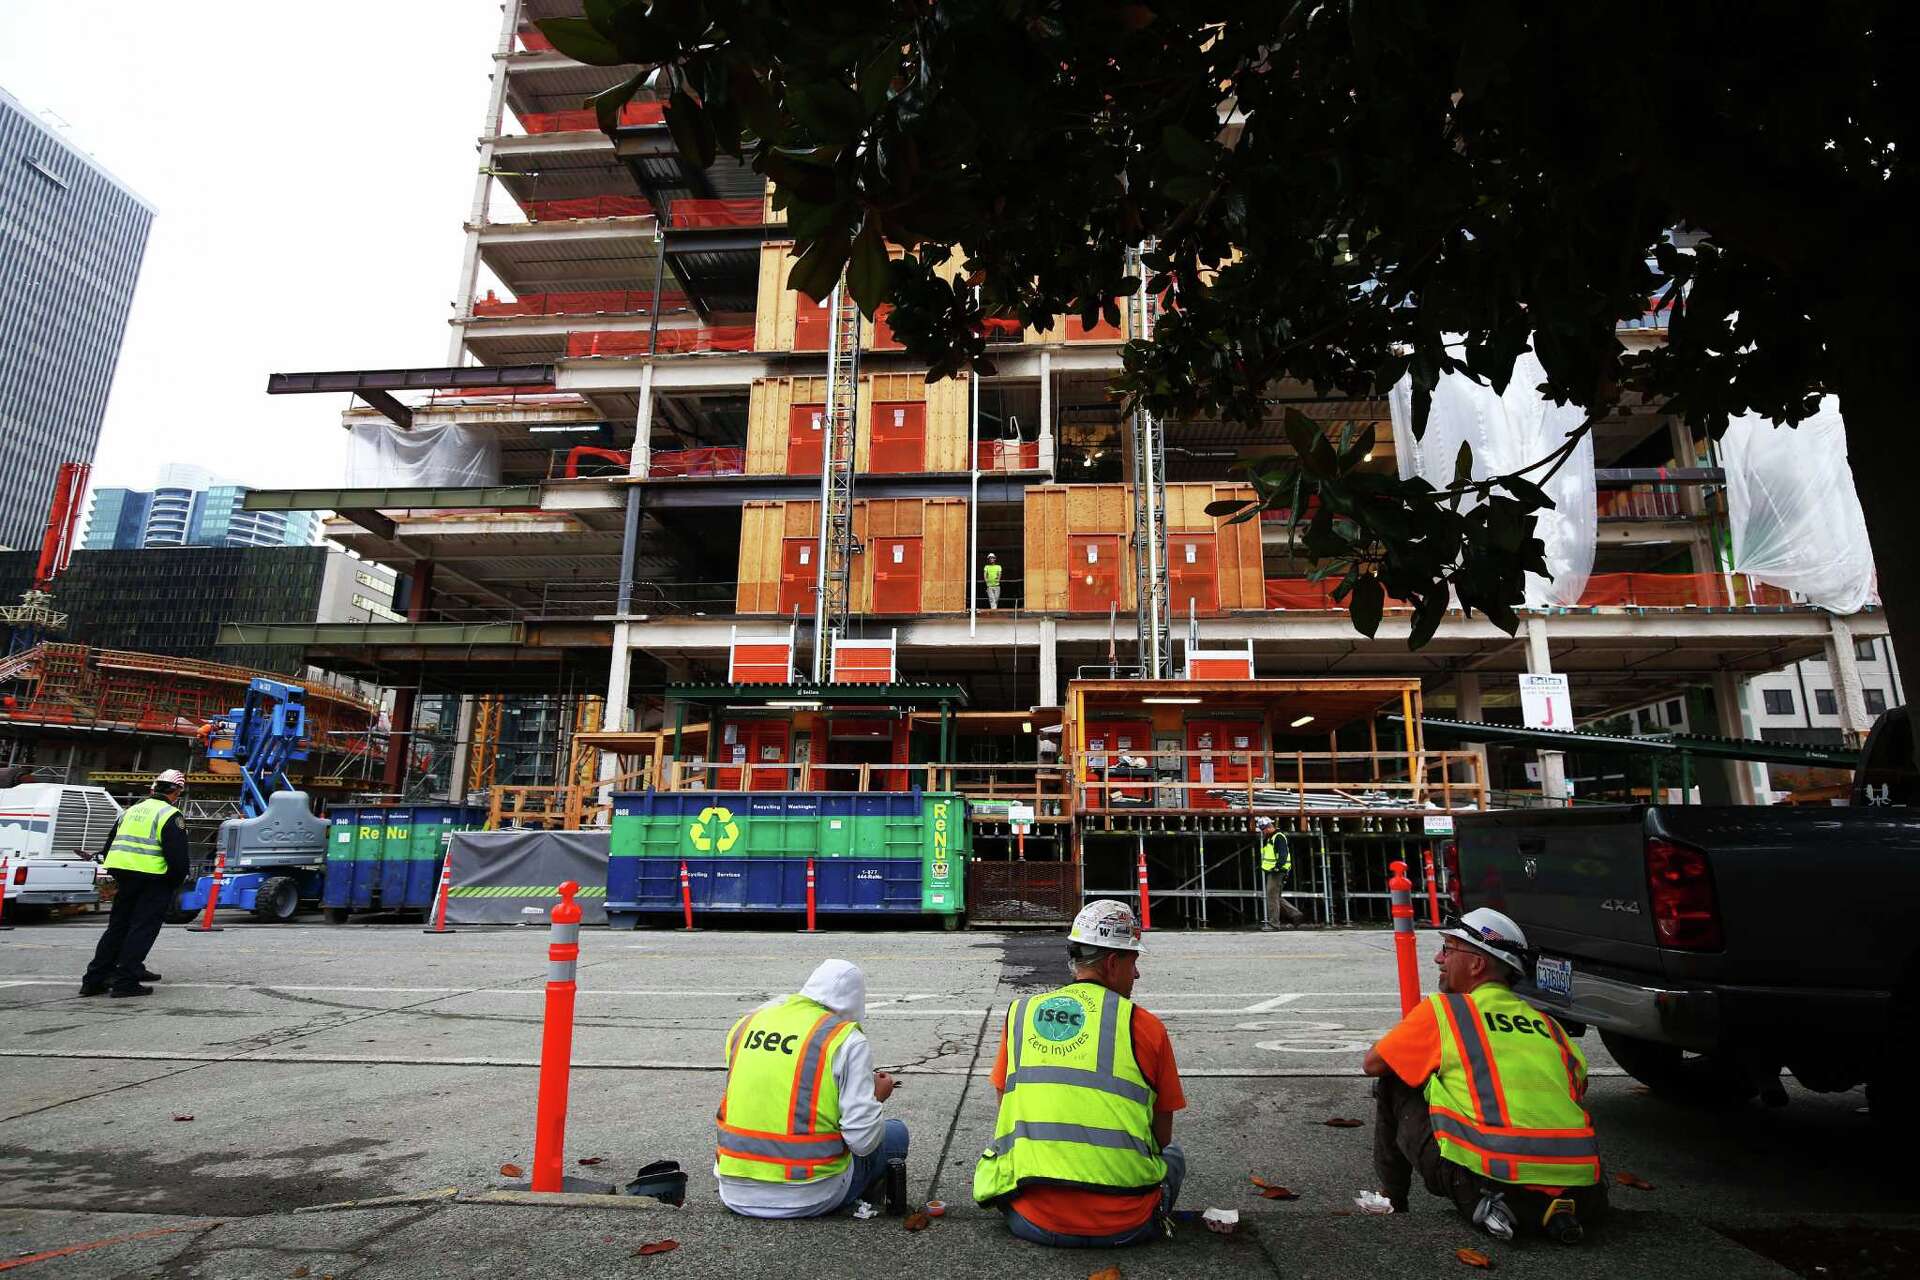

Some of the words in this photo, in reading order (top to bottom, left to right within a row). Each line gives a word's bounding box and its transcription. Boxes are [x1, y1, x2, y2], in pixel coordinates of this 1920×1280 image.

[1541, 696, 1553, 726] J
[257, 827, 315, 843] Genie
[1079, 990, 1098, 1014] Safety
[1028, 1032, 1049, 1054] Zero
